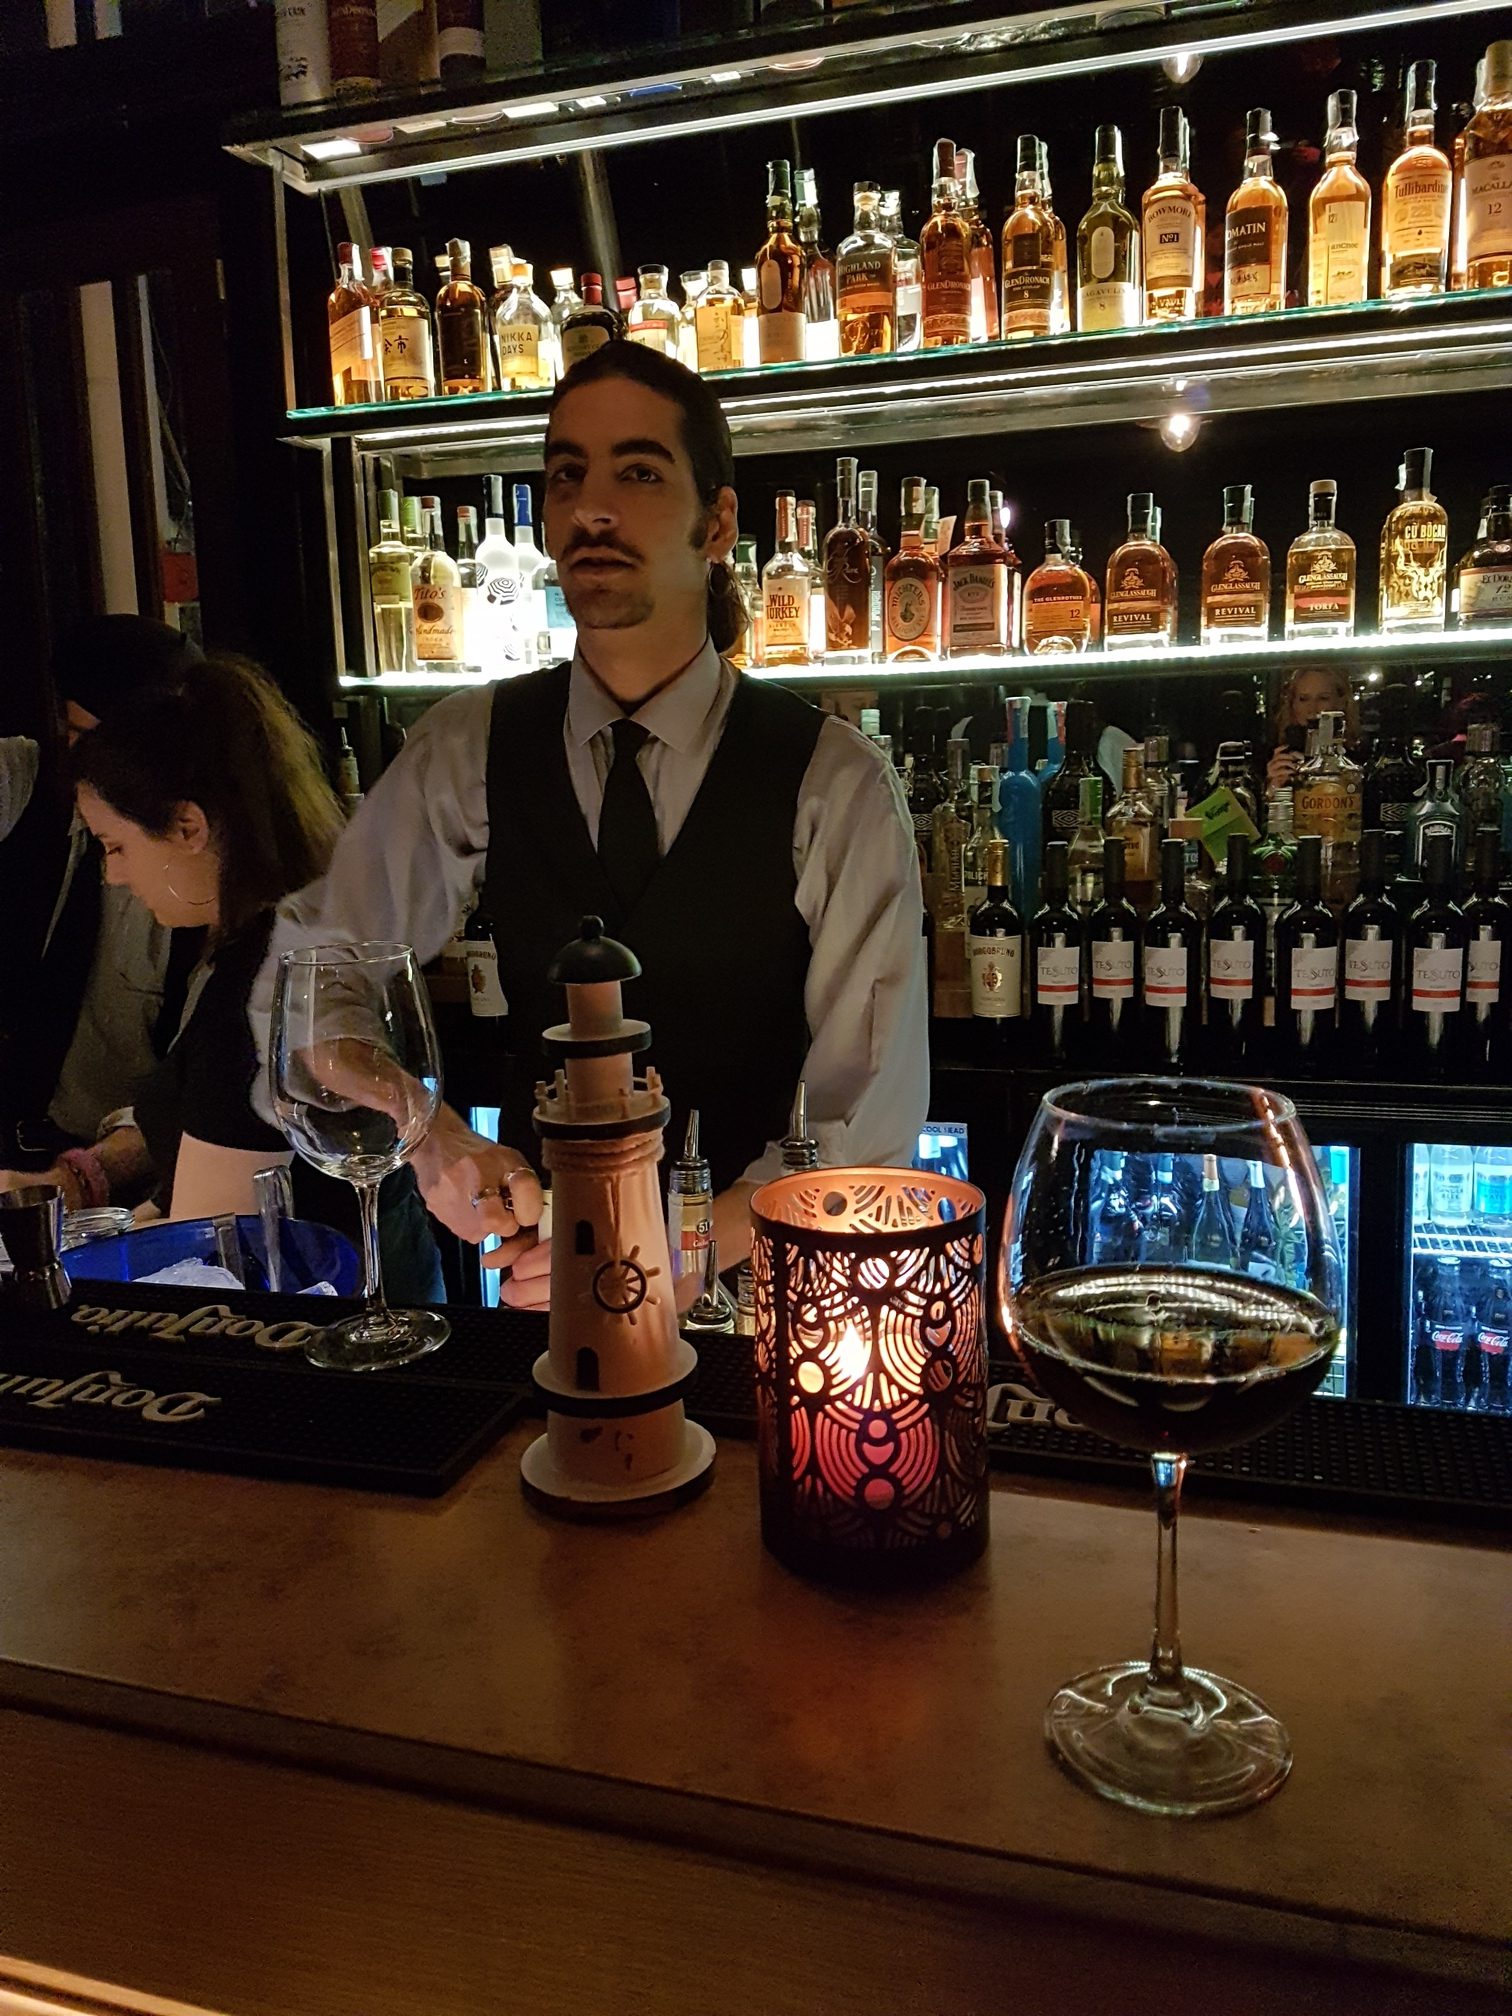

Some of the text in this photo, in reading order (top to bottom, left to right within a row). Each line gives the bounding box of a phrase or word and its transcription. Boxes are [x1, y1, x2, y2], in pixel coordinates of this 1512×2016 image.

[1488, 203, 1502, 216] 12
[846, 272, 869, 285] PARK
[501, 331, 533, 343] NIKKA
[502, 344, 525, 357] DAYS
[414, 586, 447, 601] Tito's
[768, 593, 796, 608] WILD
[766, 604, 800, 621] TURKEY
[1070, 608, 1080, 619] 12
[1214, 606, 1257, 616] REVIVAL
[1113, 613, 1152, 623] REVIVAL
[698, 1221, 709, 1233] 51
[1431, 1330, 1465, 1343] Coca-Cola
[1478, 1331, 1511, 1347] Coca-Cola
